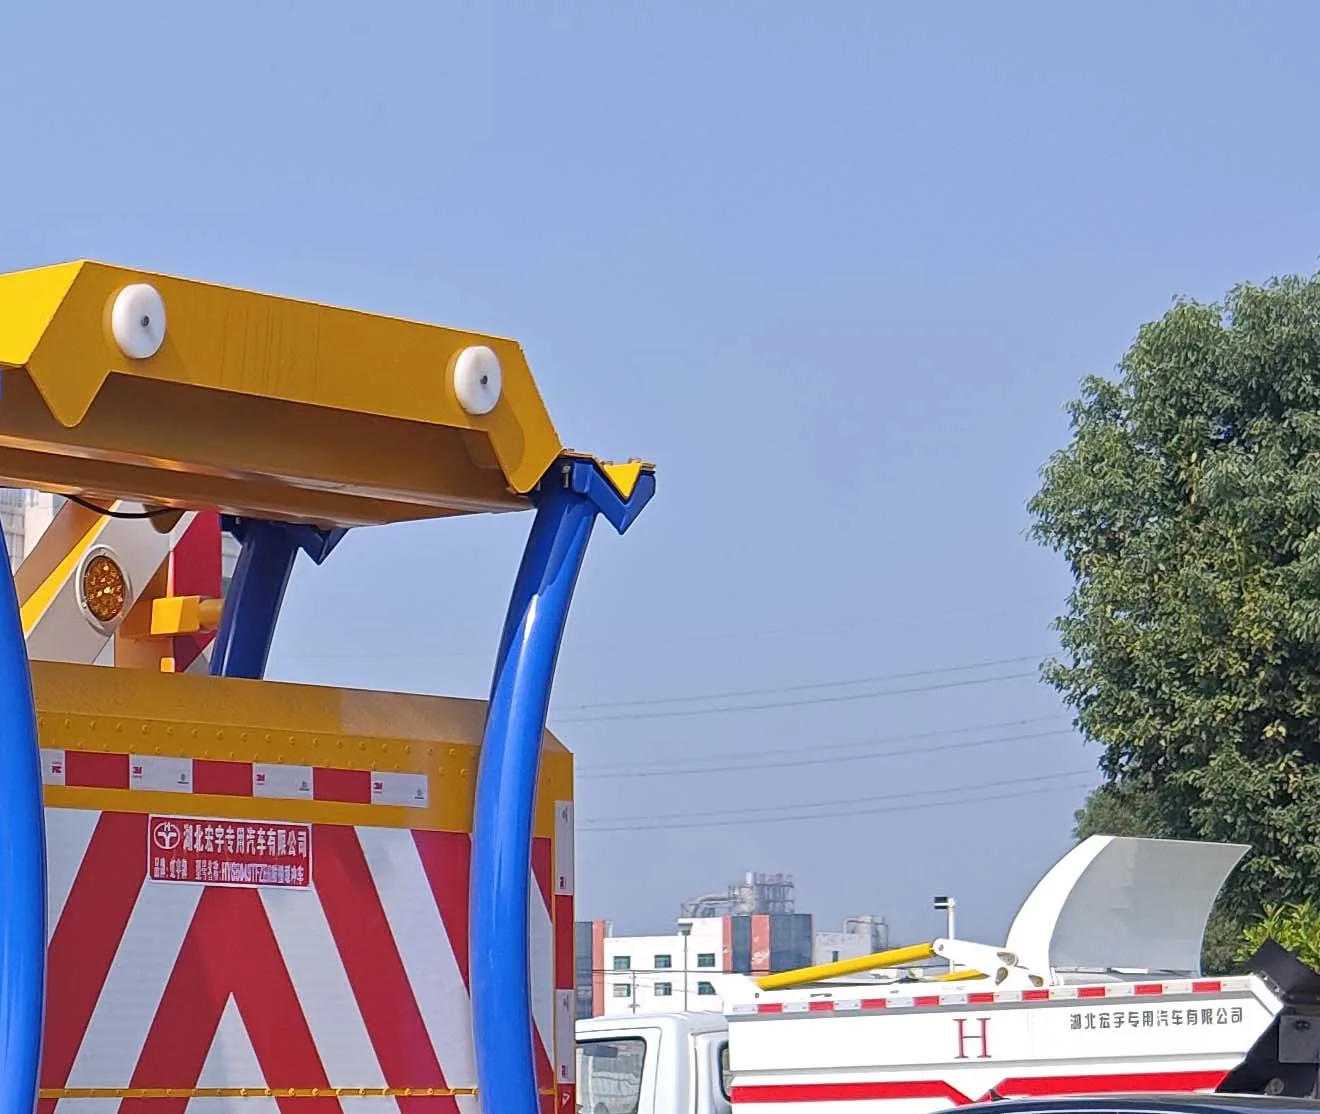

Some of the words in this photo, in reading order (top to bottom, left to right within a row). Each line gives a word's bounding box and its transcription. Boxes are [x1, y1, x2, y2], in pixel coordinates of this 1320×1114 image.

[183, 824, 308, 858] 湖北宏宇专用汽车有限公司
[1069, 1006, 1244, 1030] 湖北宏宇专用汽车有限公司
[952, 1017, 992, 1059] H
